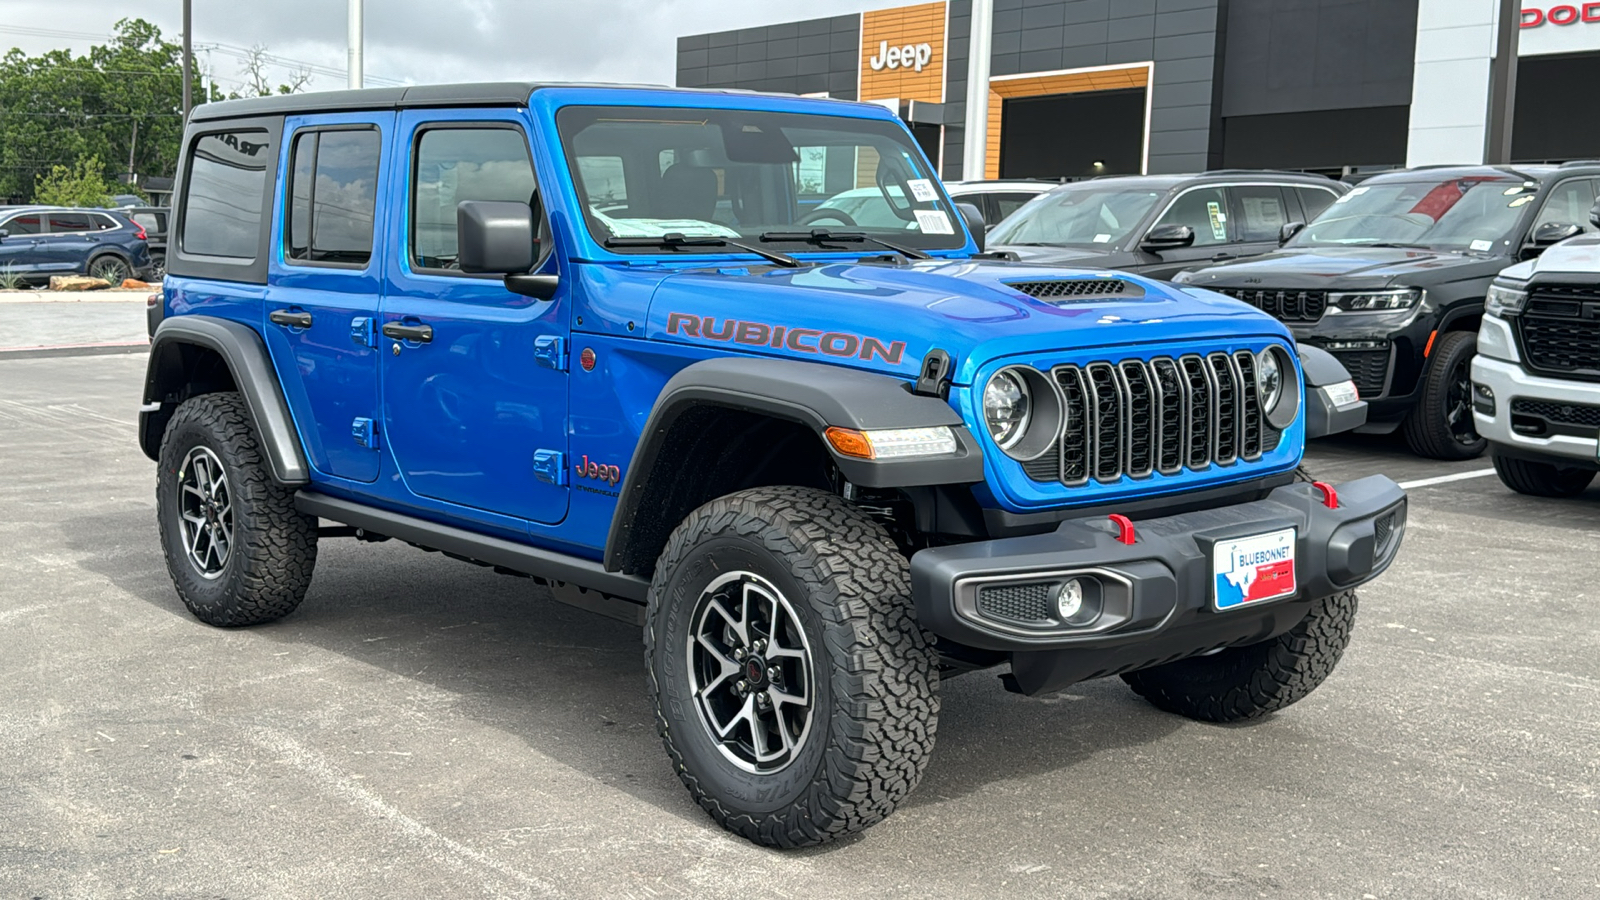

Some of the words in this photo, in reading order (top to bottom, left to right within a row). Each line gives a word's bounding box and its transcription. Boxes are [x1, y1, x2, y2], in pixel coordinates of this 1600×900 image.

[870, 40, 932, 72] Jeep
[666, 312, 907, 365] RUBICON
[575, 454, 620, 487] Jeep
[1239, 545, 1290, 568] BLUEBONNET
